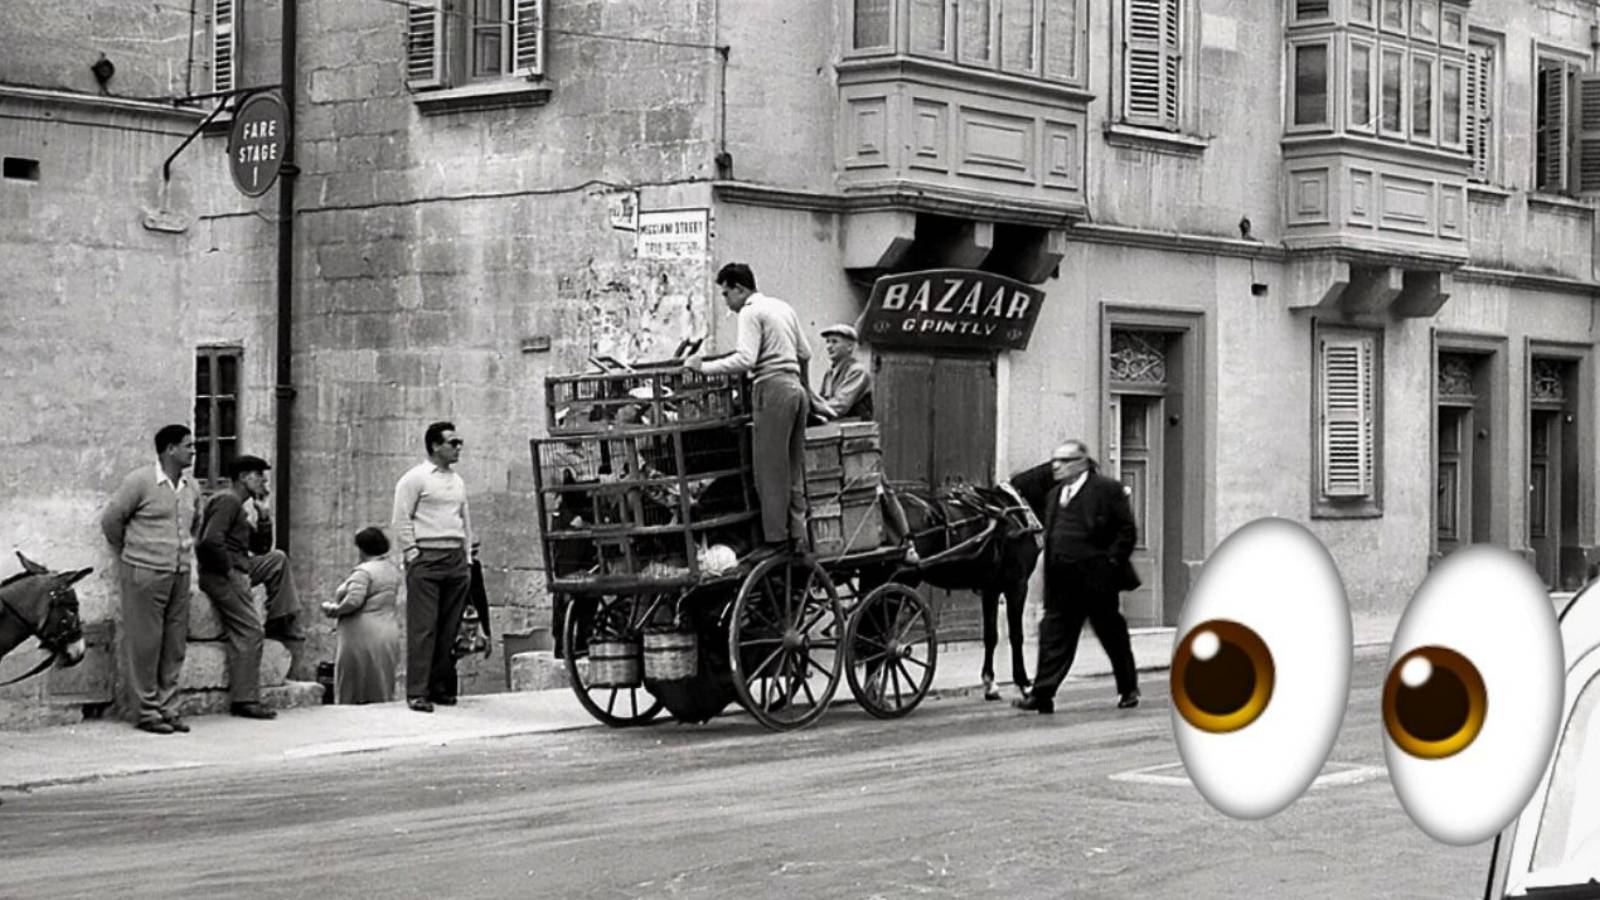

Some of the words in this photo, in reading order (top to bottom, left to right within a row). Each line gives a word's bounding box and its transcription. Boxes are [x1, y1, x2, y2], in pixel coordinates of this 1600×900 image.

[243, 120, 276, 140] FARE
[239, 143, 277, 163] STAGE
[675, 221, 703, 235] STREET
[882, 279, 1031, 319] BAZAAR
